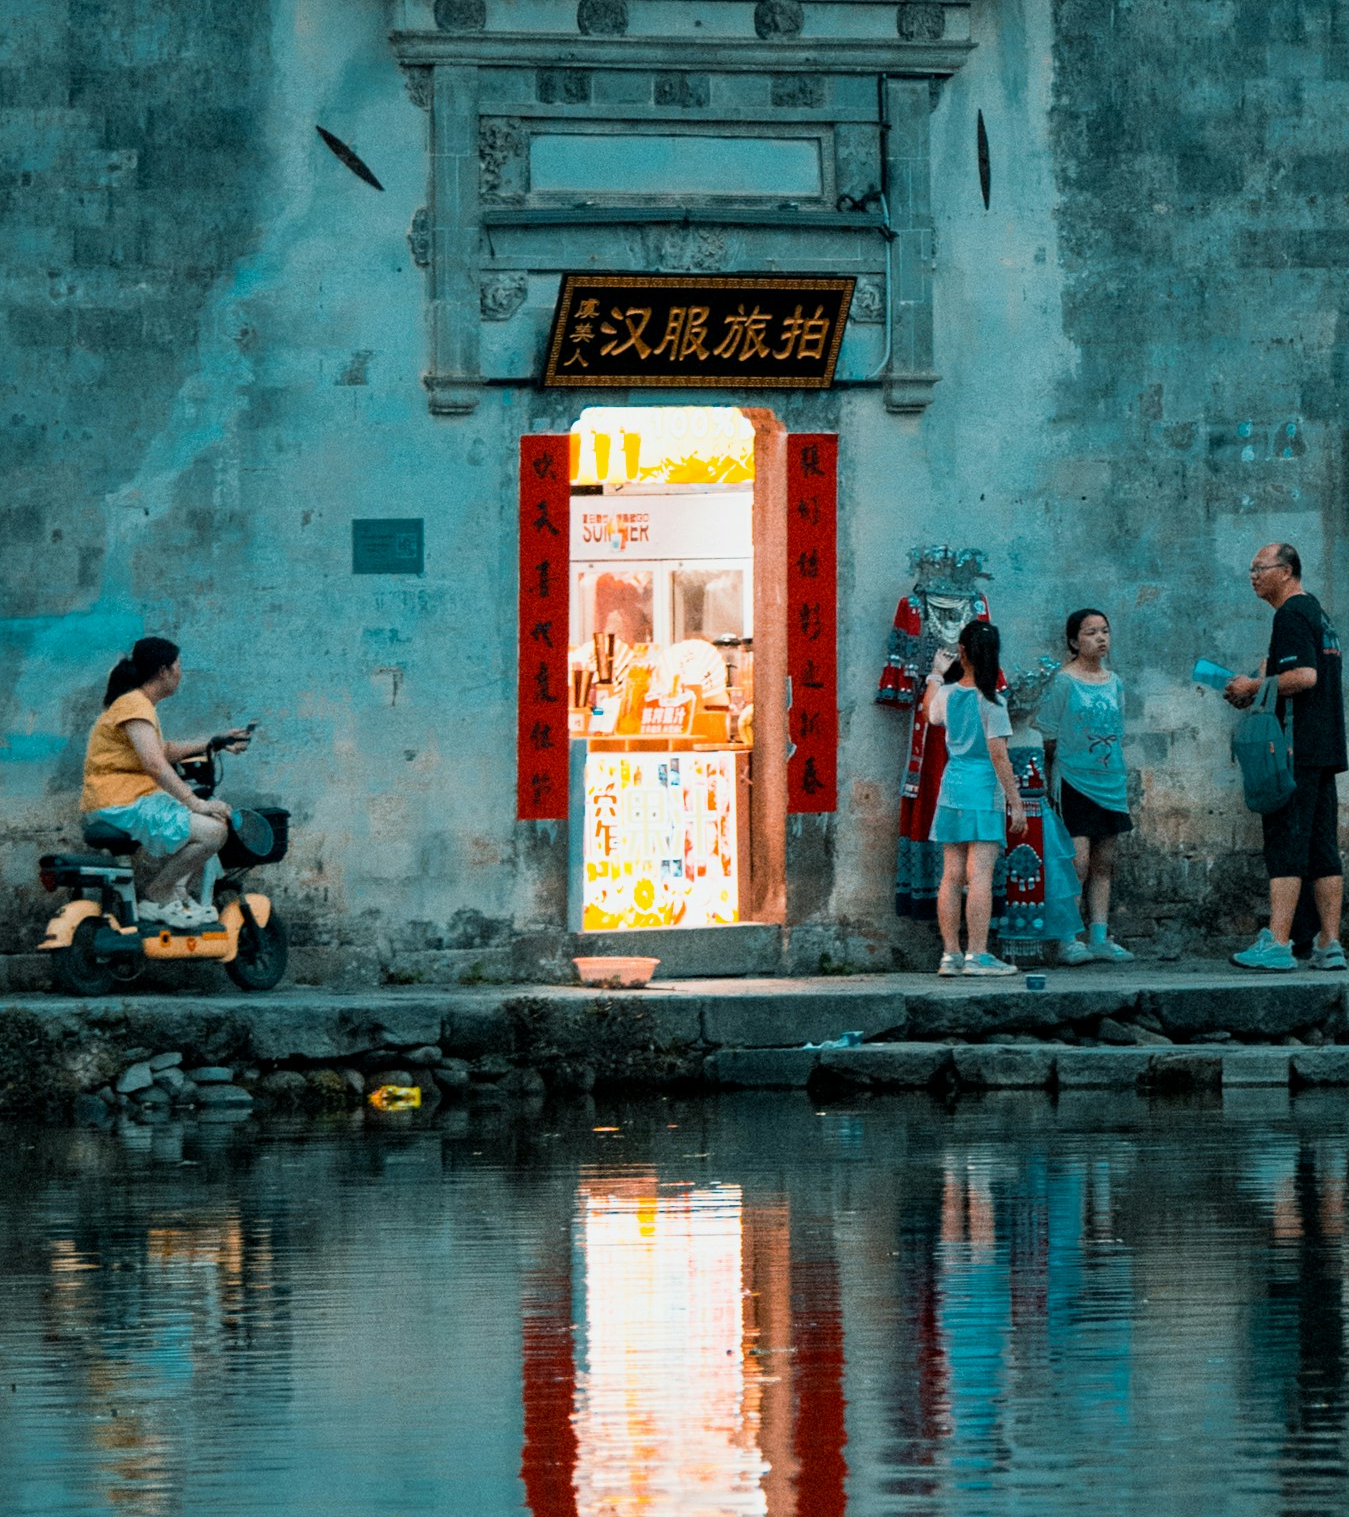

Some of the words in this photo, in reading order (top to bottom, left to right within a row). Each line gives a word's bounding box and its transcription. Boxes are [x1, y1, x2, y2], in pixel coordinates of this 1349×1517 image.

[563, 298, 600, 368] 虞美人
[600, 303, 829, 362] 汉服旅拍
